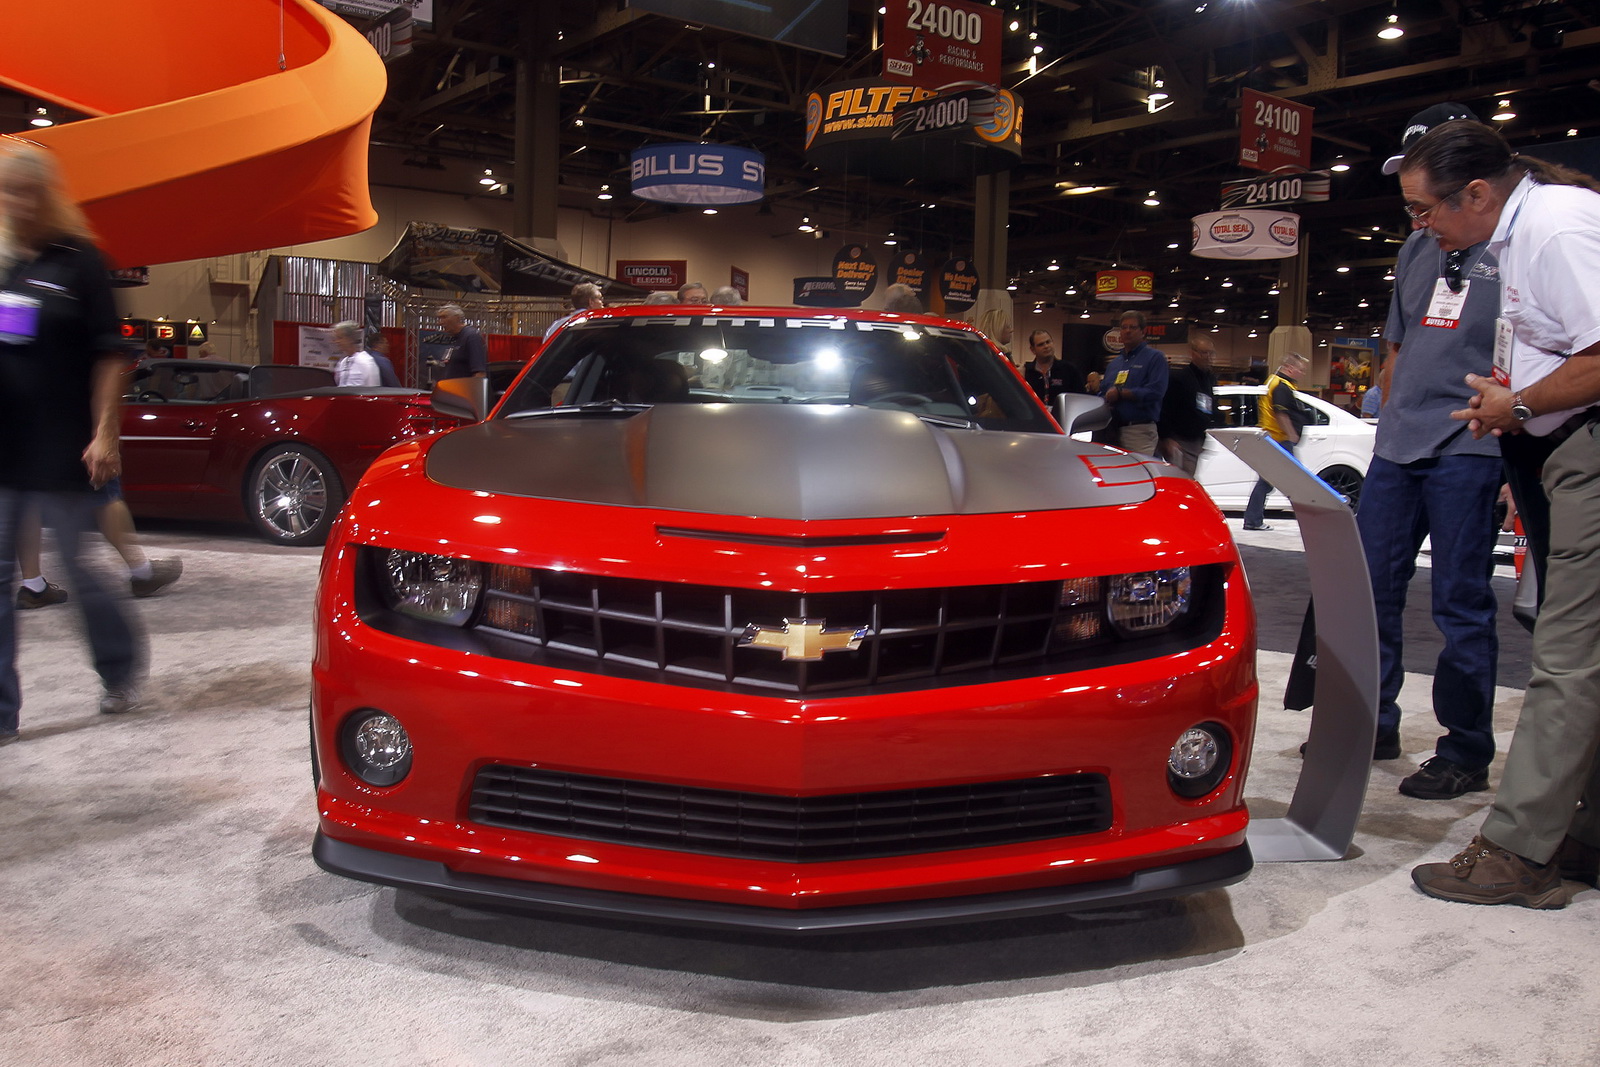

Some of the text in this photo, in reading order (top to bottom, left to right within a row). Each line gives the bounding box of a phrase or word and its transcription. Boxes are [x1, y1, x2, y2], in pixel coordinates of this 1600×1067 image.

[907, 0, 983, 44] 24000
[947, 44, 977, 60] RACING &
[940, 54, 984, 73] PERFORMANCE
[914, 97, 969, 132] 24000
[1254, 100, 1300, 136] 24100
[1246, 178, 1302, 204] 24100
[1213, 224, 1250, 234] TOTAL SEAL
[1273, 225, 1288, 235] TOTAL
[627, 267, 668, 276] LINCOLN
[837, 261, 876, 273] Next Day
[897, 266, 925, 277] Dealer
